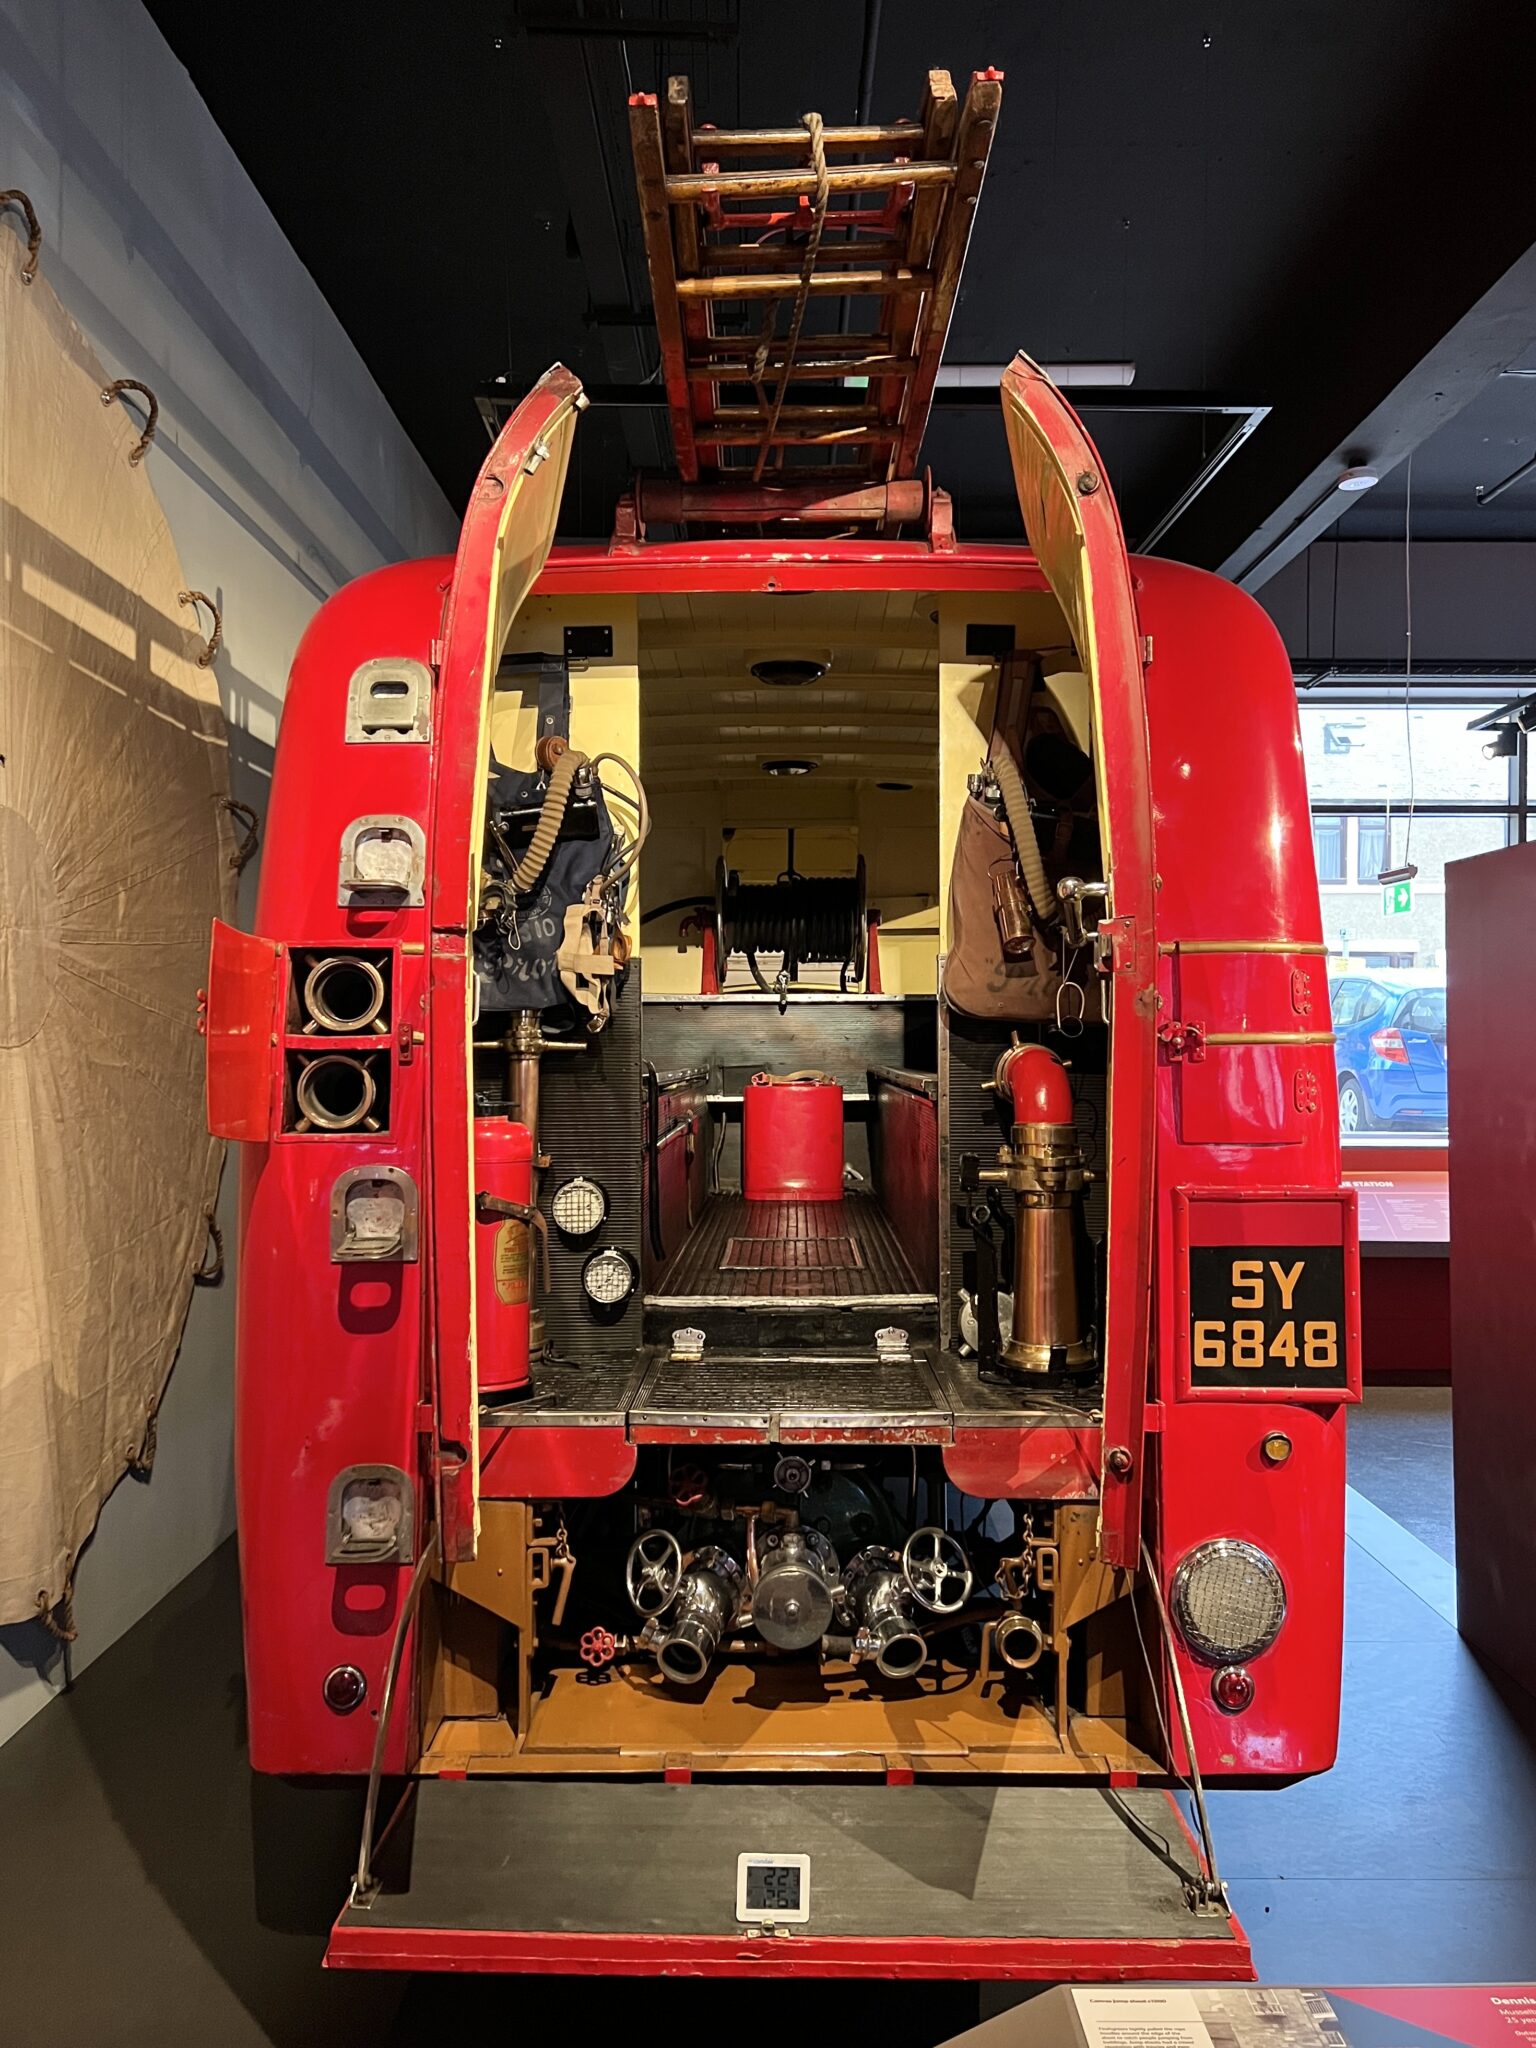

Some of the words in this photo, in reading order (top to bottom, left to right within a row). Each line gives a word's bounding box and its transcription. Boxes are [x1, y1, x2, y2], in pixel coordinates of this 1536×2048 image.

[1231, 1260, 1305, 1310] SY
[1194, 1320, 1338, 1368] 6848
[764, 1867, 789, 1886] 22
